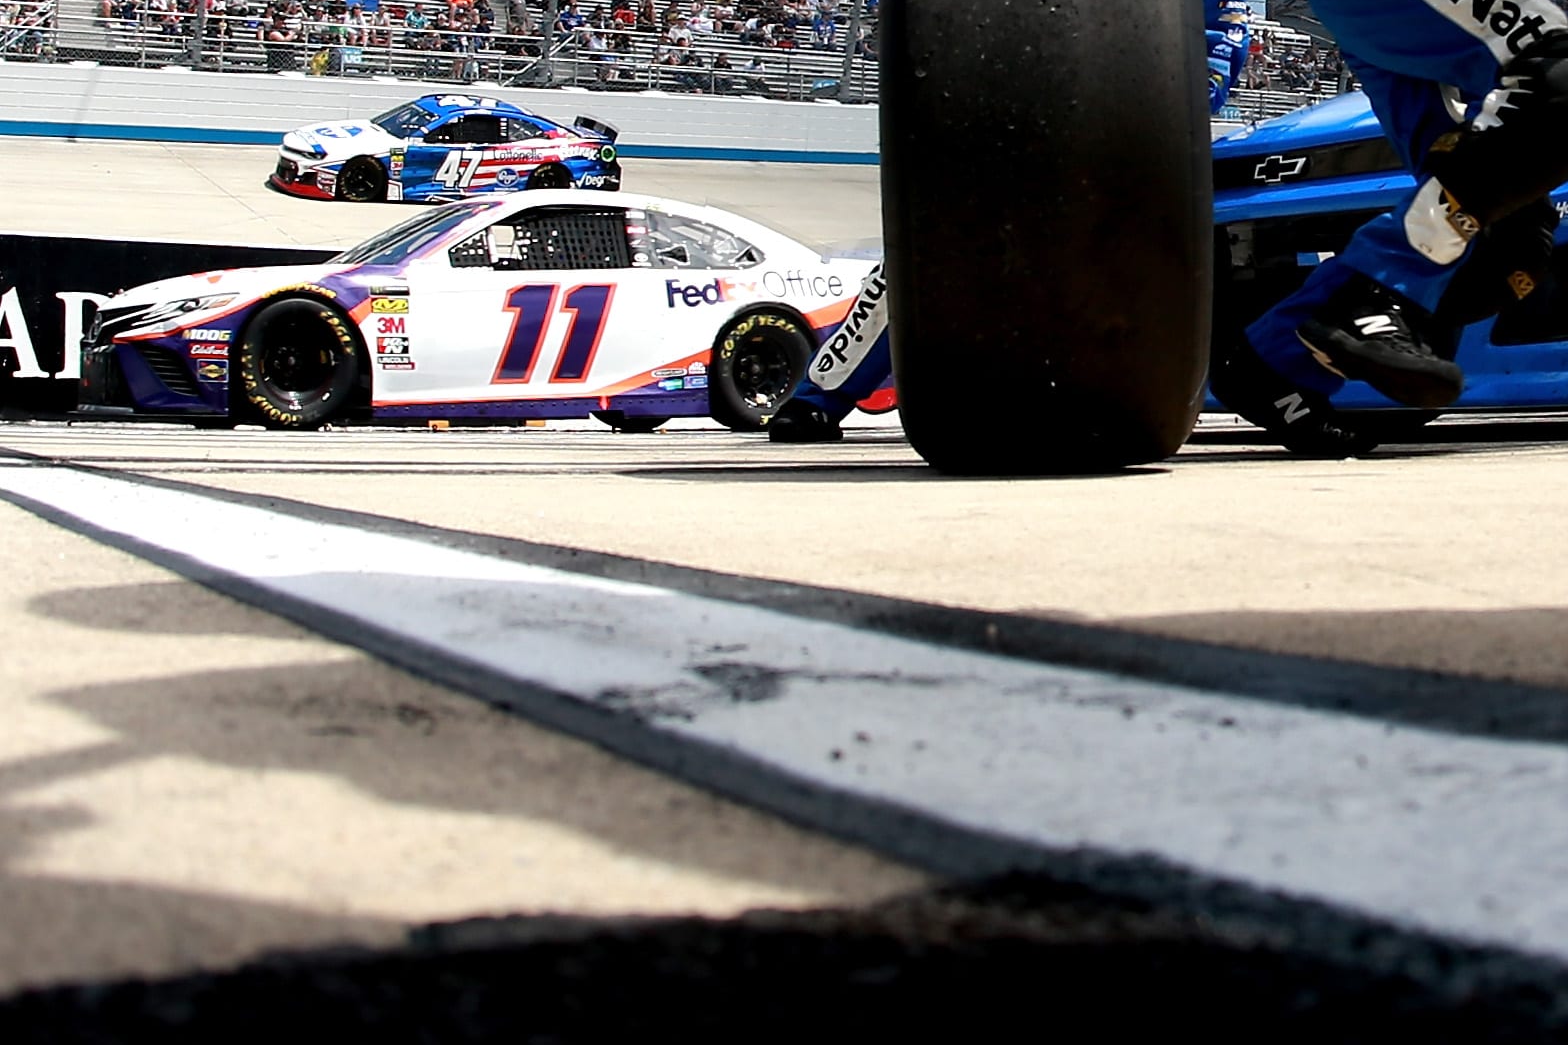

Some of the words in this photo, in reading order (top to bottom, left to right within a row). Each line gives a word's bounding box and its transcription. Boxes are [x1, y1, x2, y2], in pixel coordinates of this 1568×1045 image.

[434, 148, 483, 188] 47
[762, 270, 844, 299] Office
[182, 328, 232, 342] MOOG
[377, 316, 405, 334] 3M
[490, 281, 618, 384] 11
[1353, 314, 1399, 335] N
[1273, 392, 1311, 424] N
